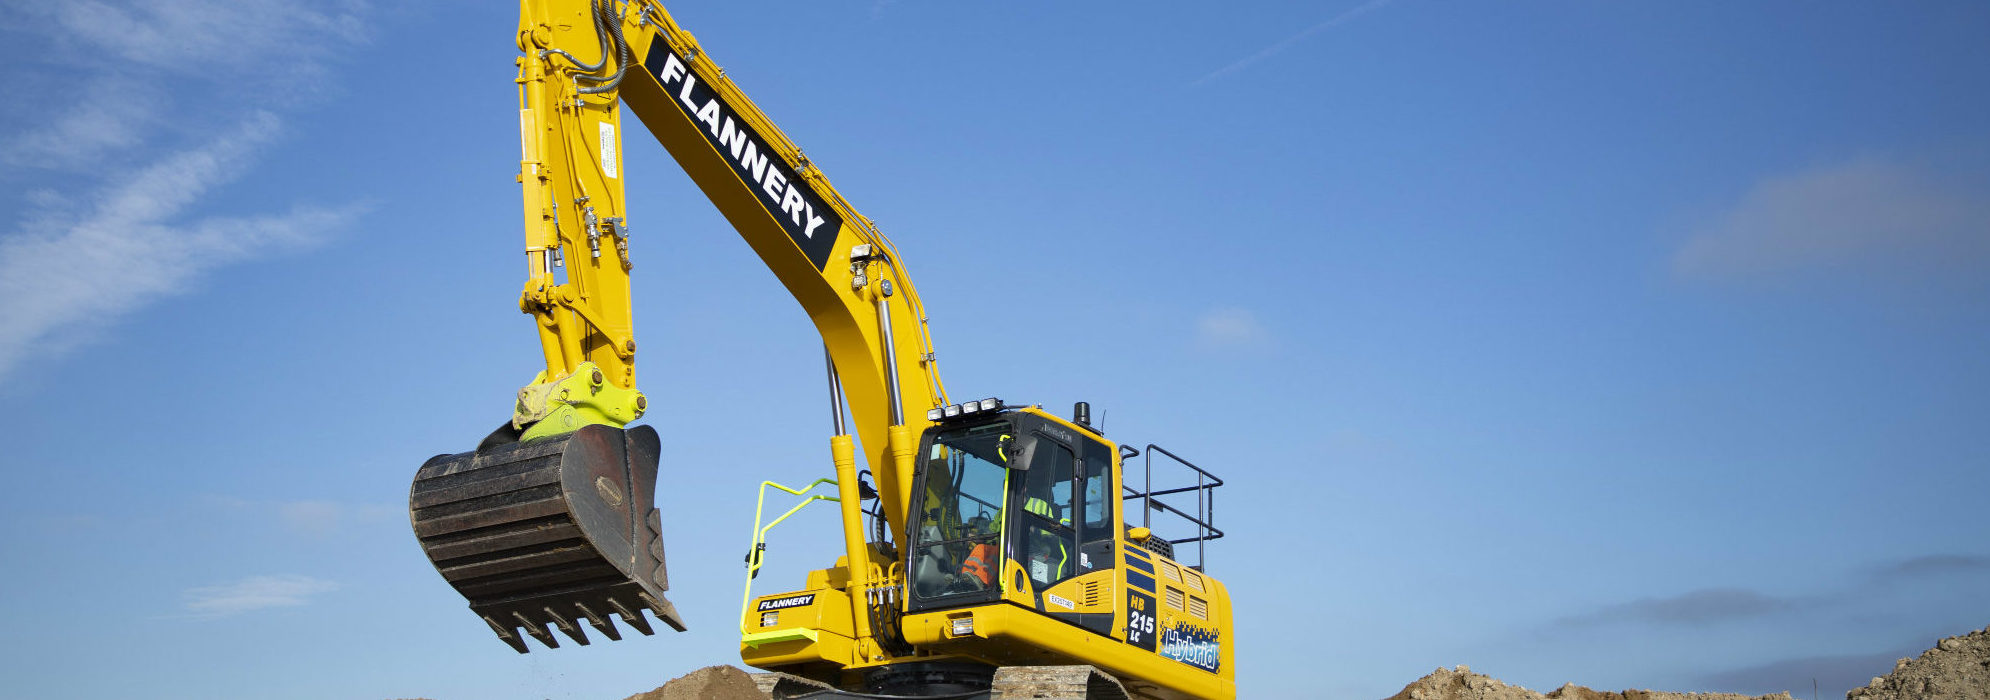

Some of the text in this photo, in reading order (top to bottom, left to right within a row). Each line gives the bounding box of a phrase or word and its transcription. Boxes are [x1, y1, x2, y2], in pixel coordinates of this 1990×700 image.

[660, 52, 825, 239] FLANNERY
[760, 595, 813, 610] FLANNERY
[1130, 594, 1145, 611] HB
[1129, 610, 1154, 634] 215
[1129, 629, 1141, 643] LC
[1164, 627, 1217, 670] Hybrid
